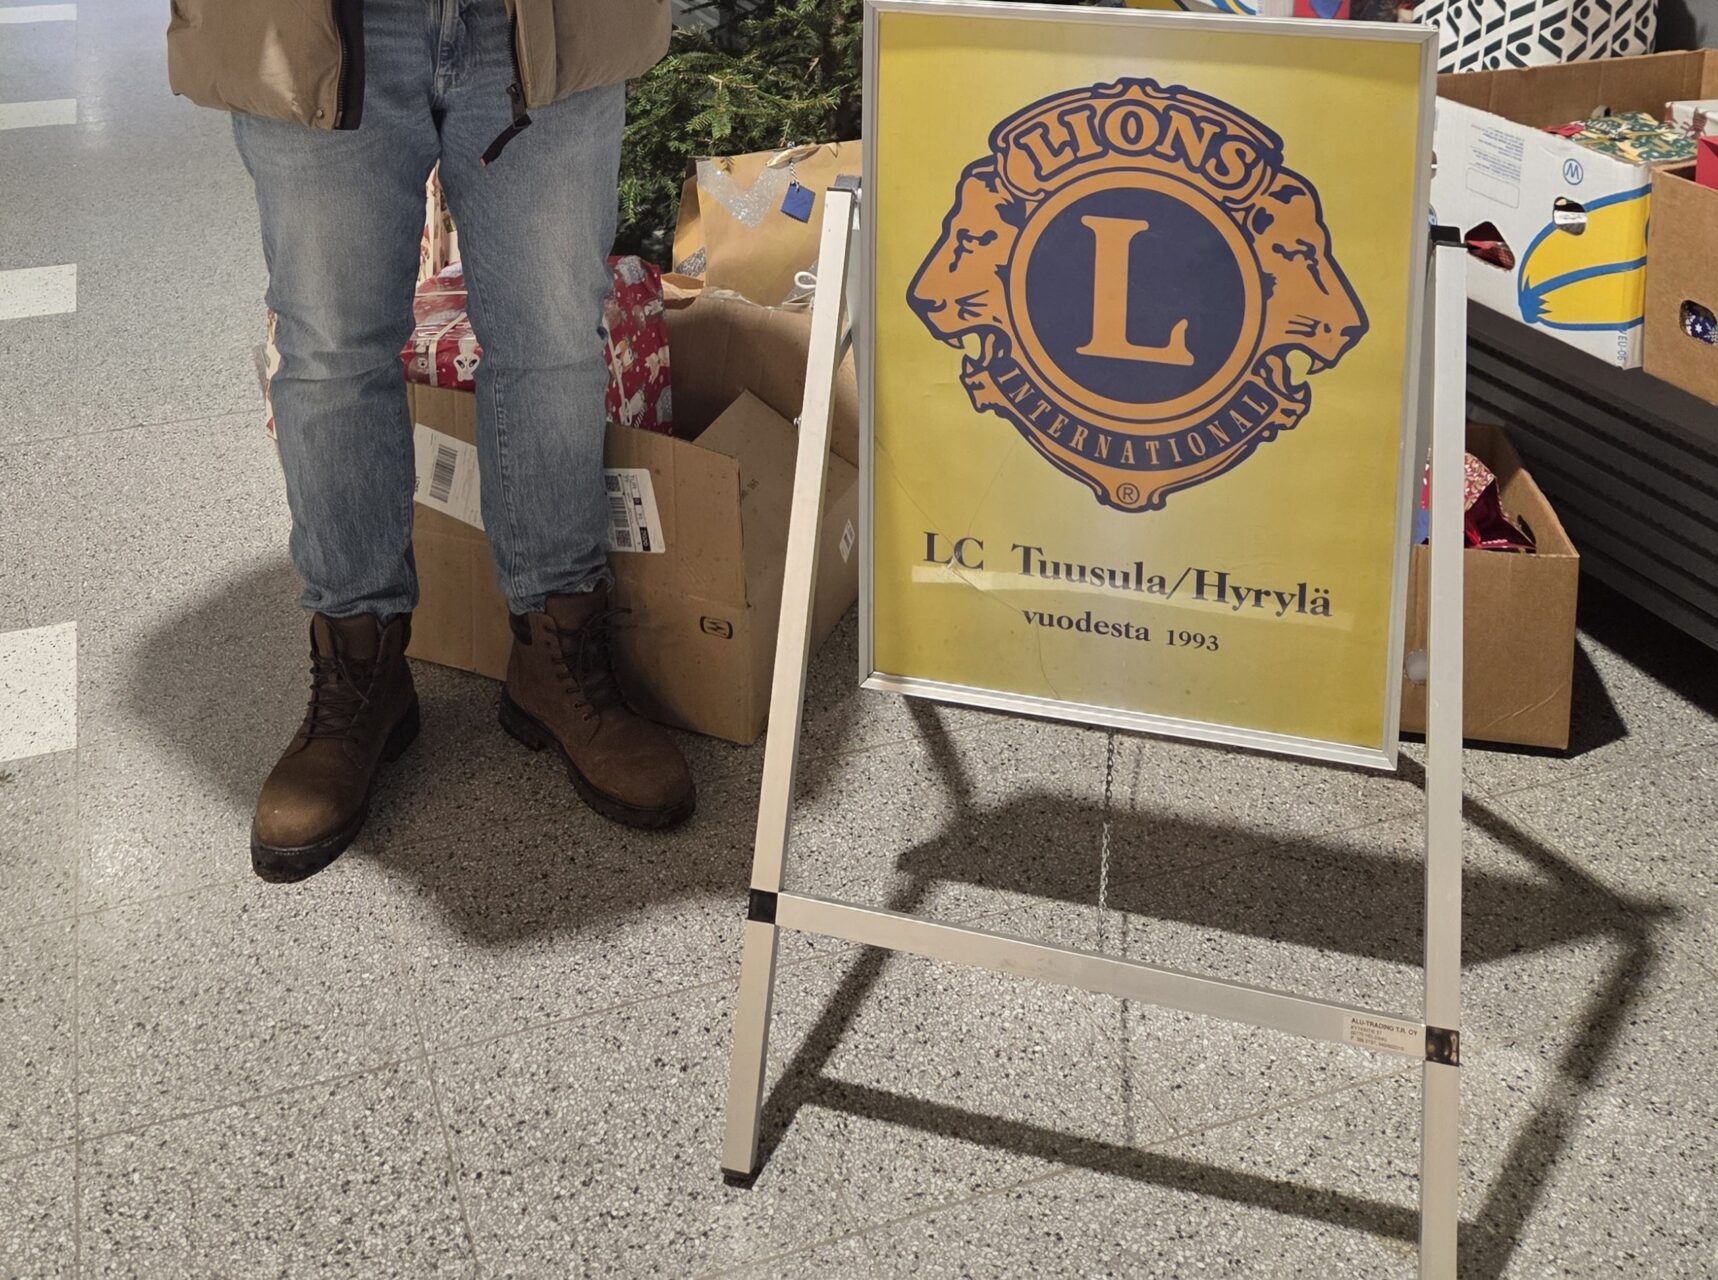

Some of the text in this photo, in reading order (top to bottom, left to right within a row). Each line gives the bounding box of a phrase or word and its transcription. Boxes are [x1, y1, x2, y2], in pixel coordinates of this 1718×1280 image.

[1017, 101, 1260, 186] LIONS
[1074, 214, 1195, 366] L
[996, 365, 1271, 467] INTERNATIONAL
[922, 530, 1333, 618] LC Tuusula/Hyrylä
[1021, 608, 1220, 652] vuodesta 1993
[1351, 1017, 1394, 1032] ALU-TRADING
